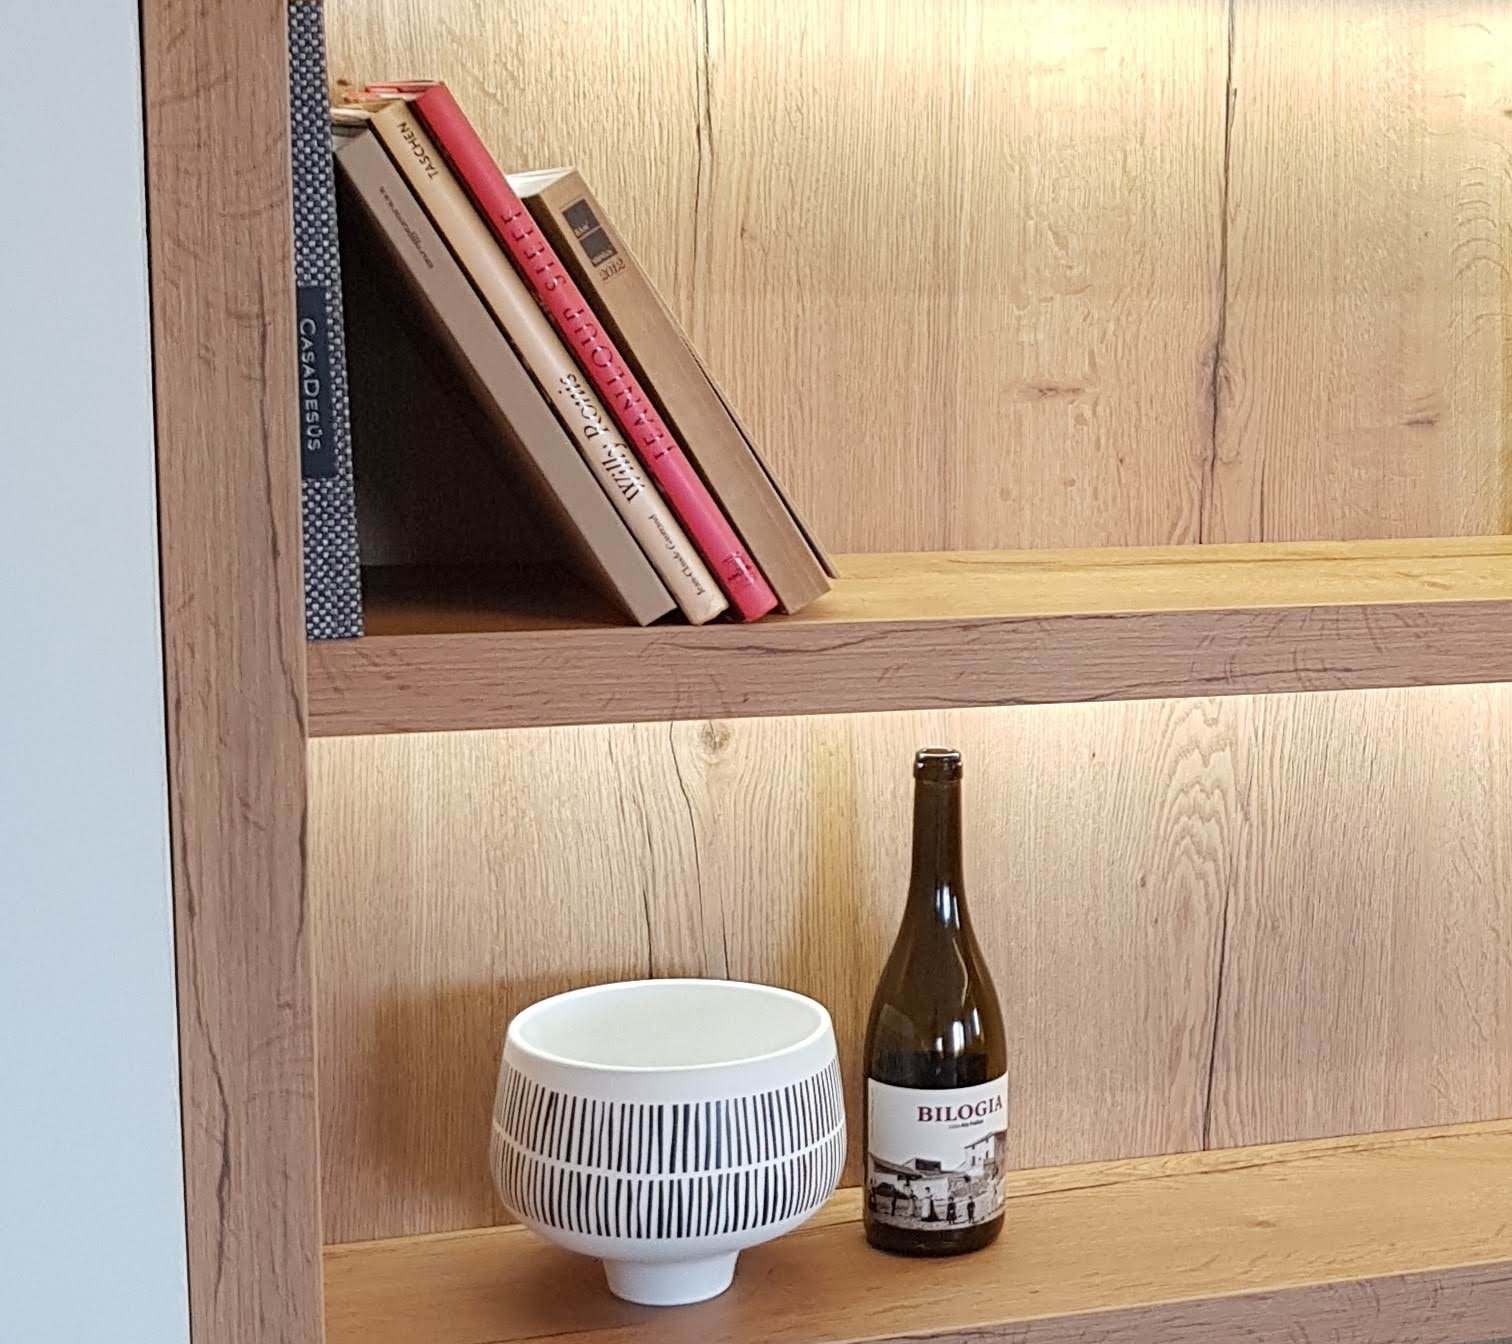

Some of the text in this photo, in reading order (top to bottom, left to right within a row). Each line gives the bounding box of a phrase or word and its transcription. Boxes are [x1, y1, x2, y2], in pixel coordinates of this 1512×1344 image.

[397, 122, 439, 180] TASCHEN
[600, 258, 626, 281] 2012
[558, 373, 645, 502] Willy Ronis
[917, 1095, 1003, 1123] BILOGIA
